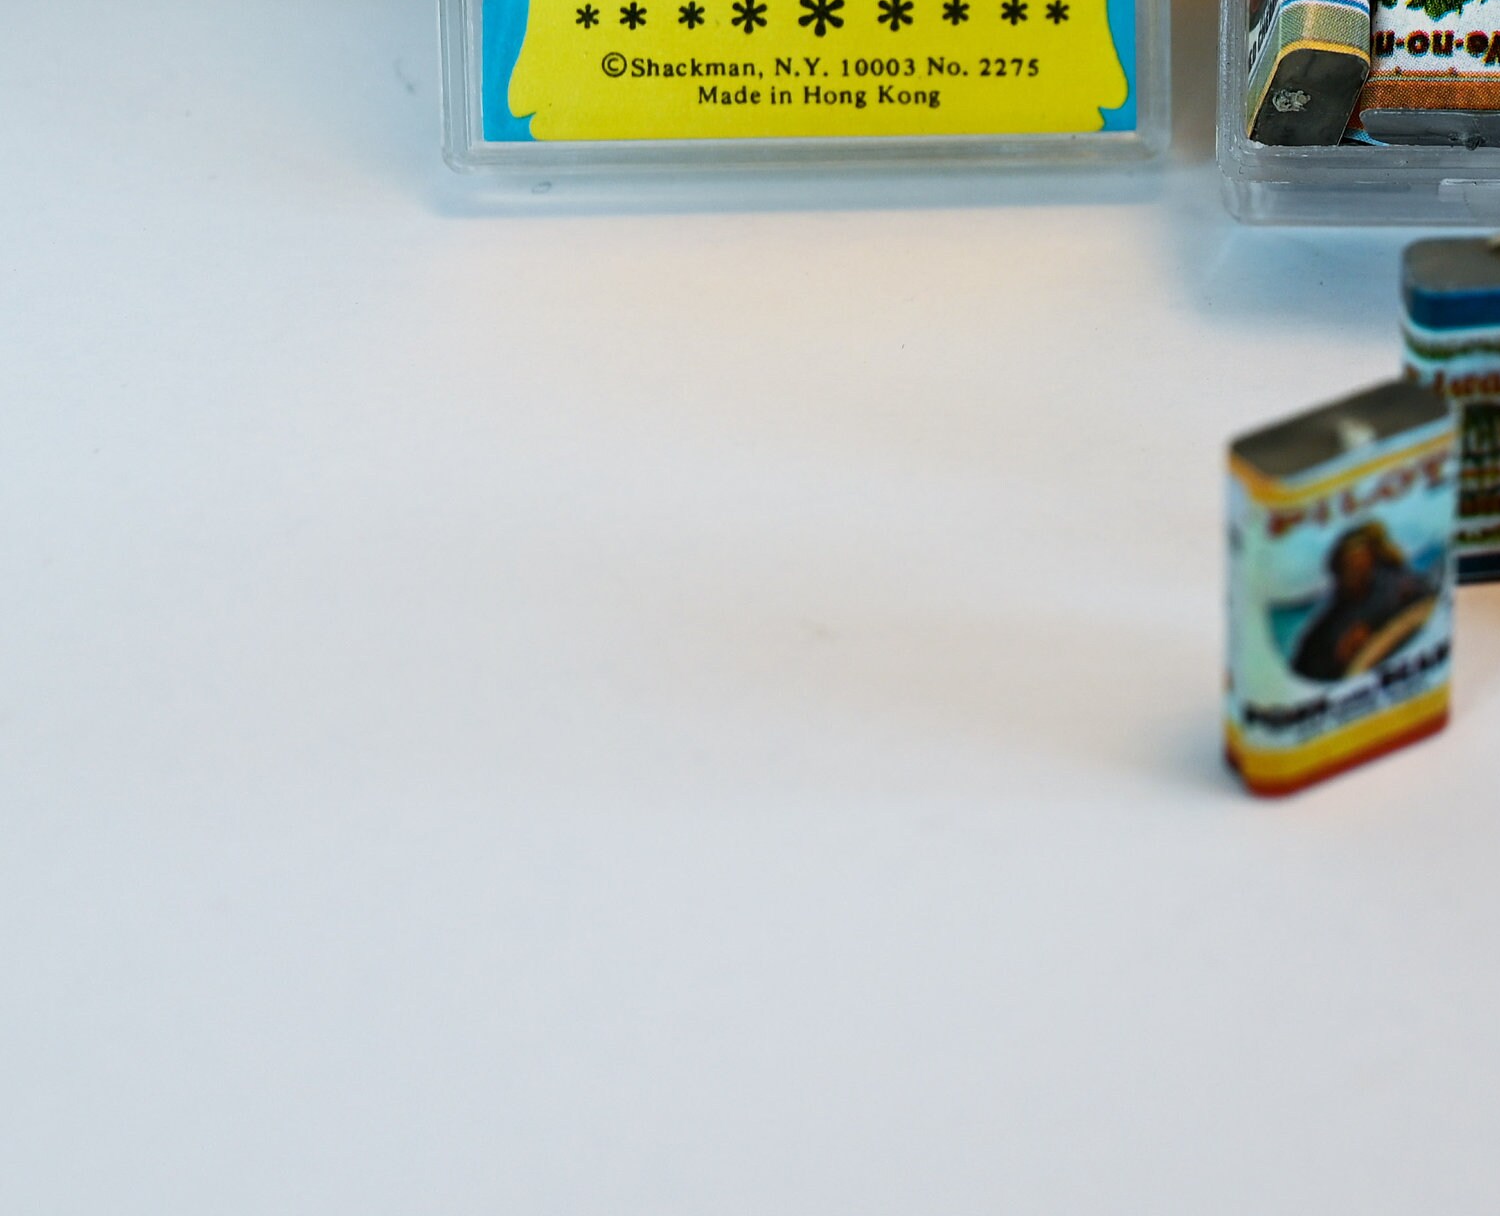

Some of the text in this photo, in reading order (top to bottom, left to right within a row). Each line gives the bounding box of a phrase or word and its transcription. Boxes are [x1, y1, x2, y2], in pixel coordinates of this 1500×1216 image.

[776, 58, 828, 76] N.Y.
[843, 59, 915, 76] 10003
[928, 57, 967, 76] No.
[980, 58, 1038, 76] 2275
[699, 86, 940, 108] Made in Hong Kong
